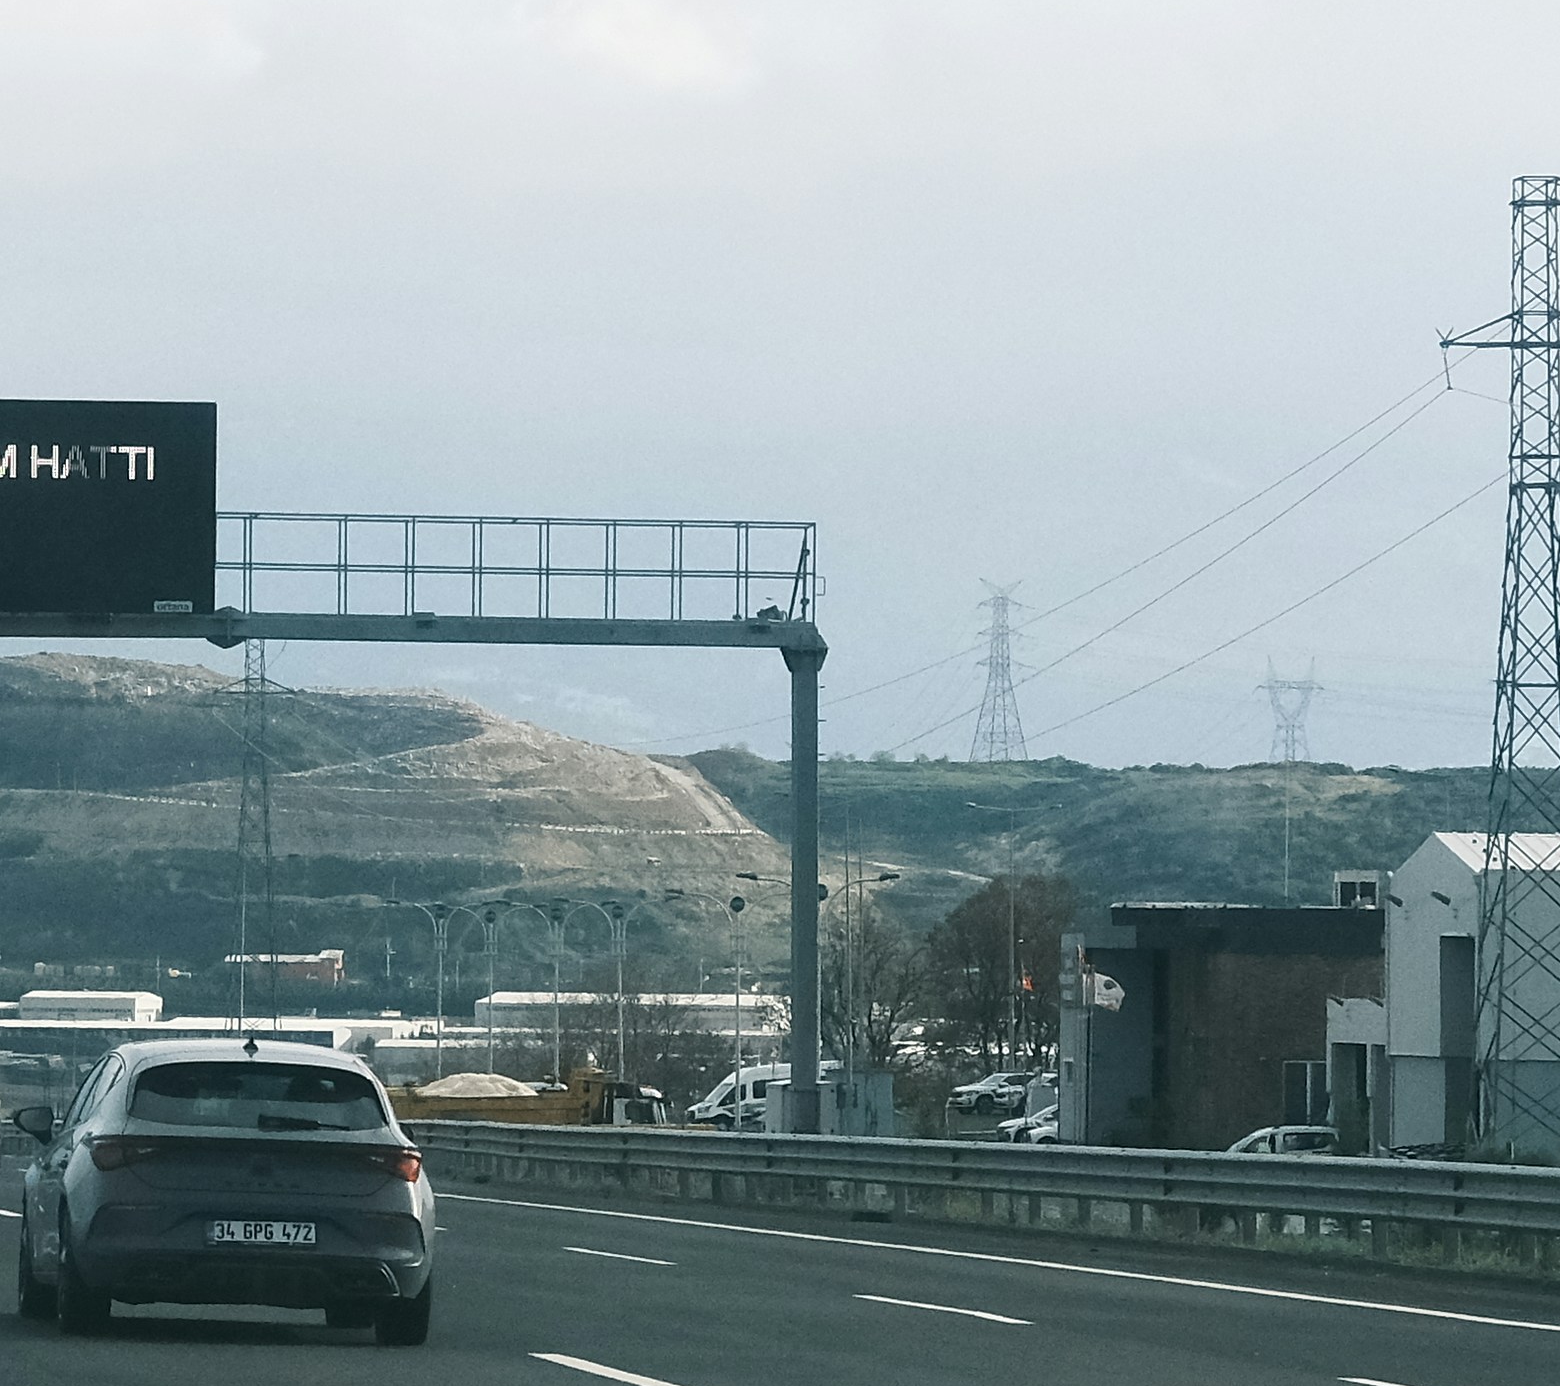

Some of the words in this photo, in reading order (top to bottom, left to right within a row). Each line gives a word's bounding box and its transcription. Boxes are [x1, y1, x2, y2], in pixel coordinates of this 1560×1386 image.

[30, 443, 155, 481] HATTI
[215, 1222, 236, 1240] 34
[243, 1222, 274, 1241] GPG
[281, 1223, 313, 1242] 472
